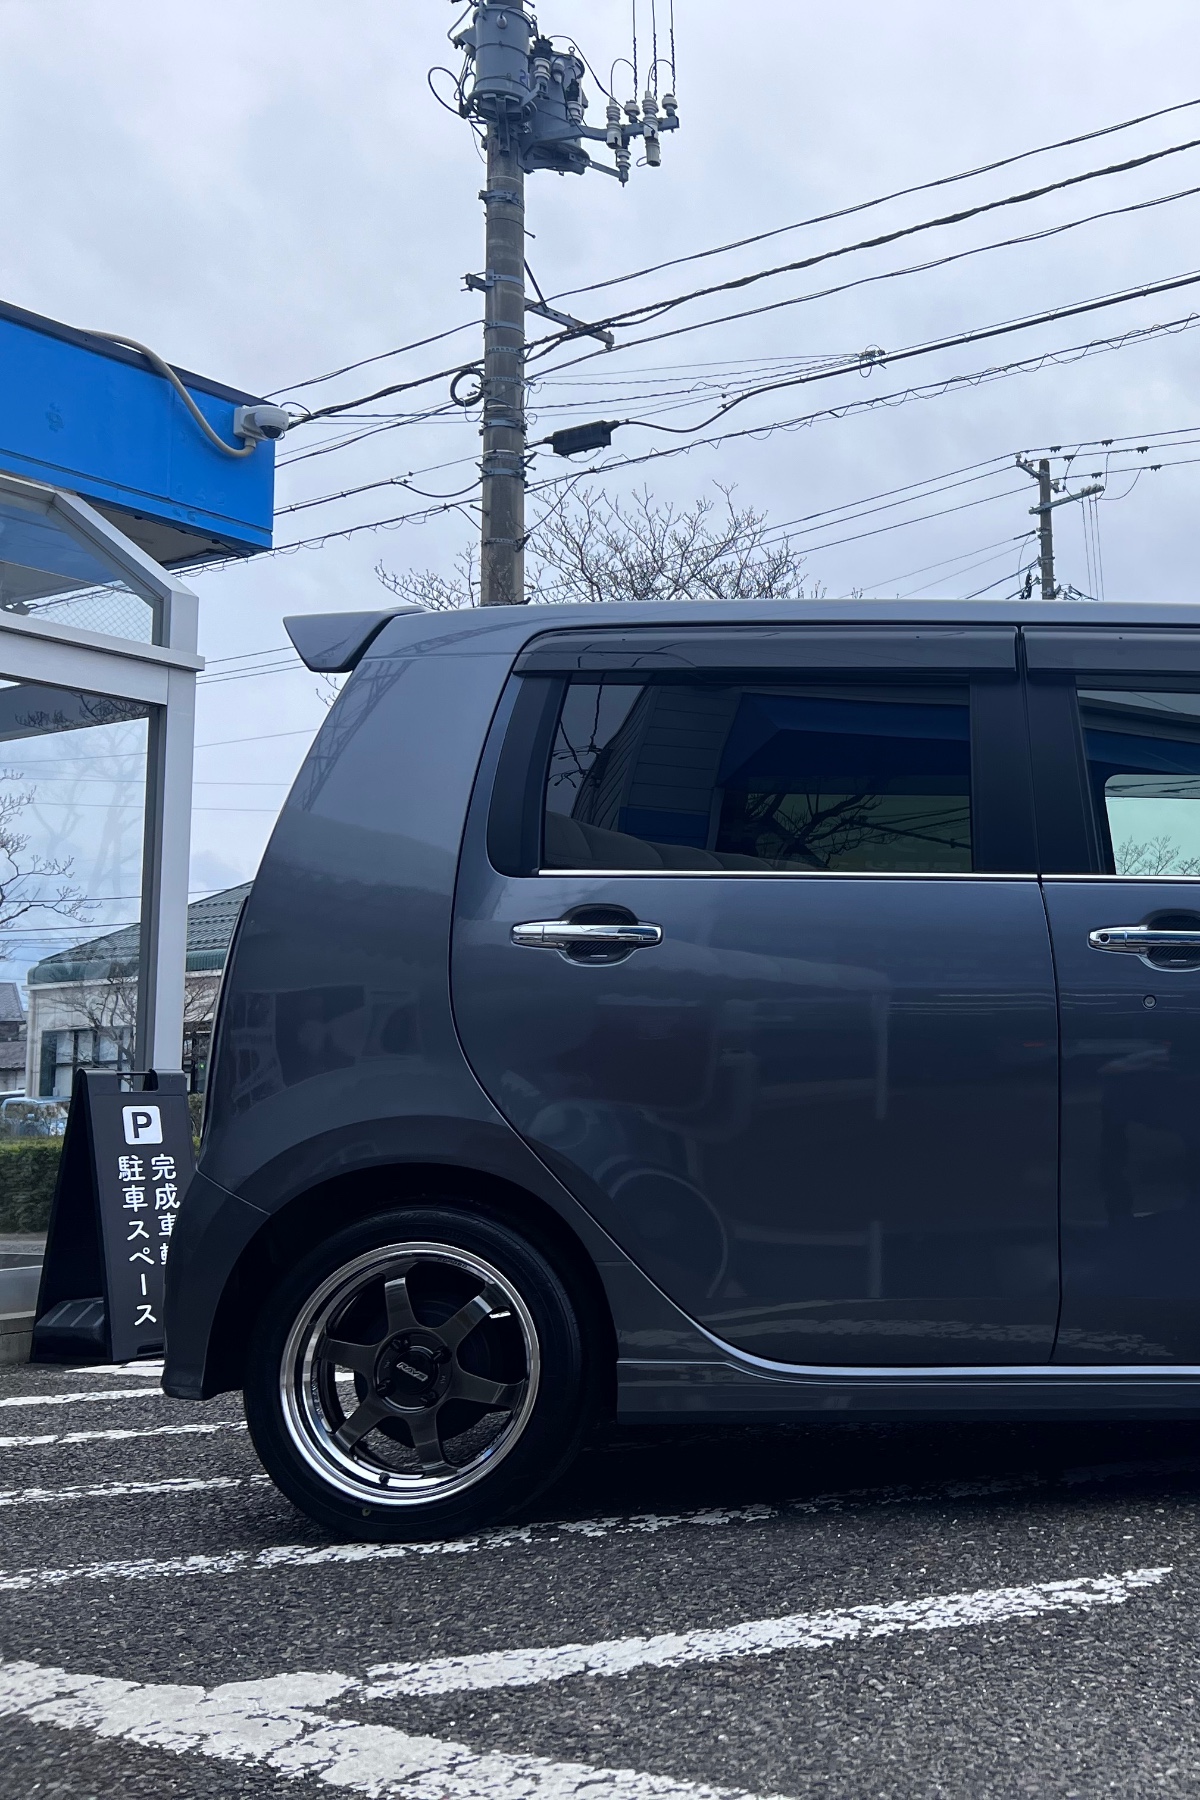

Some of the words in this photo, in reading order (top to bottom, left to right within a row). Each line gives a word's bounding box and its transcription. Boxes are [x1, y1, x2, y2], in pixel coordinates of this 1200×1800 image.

[131, 1111, 152, 1139] P
[118, 1154, 157, 1326] 駐車スペース
